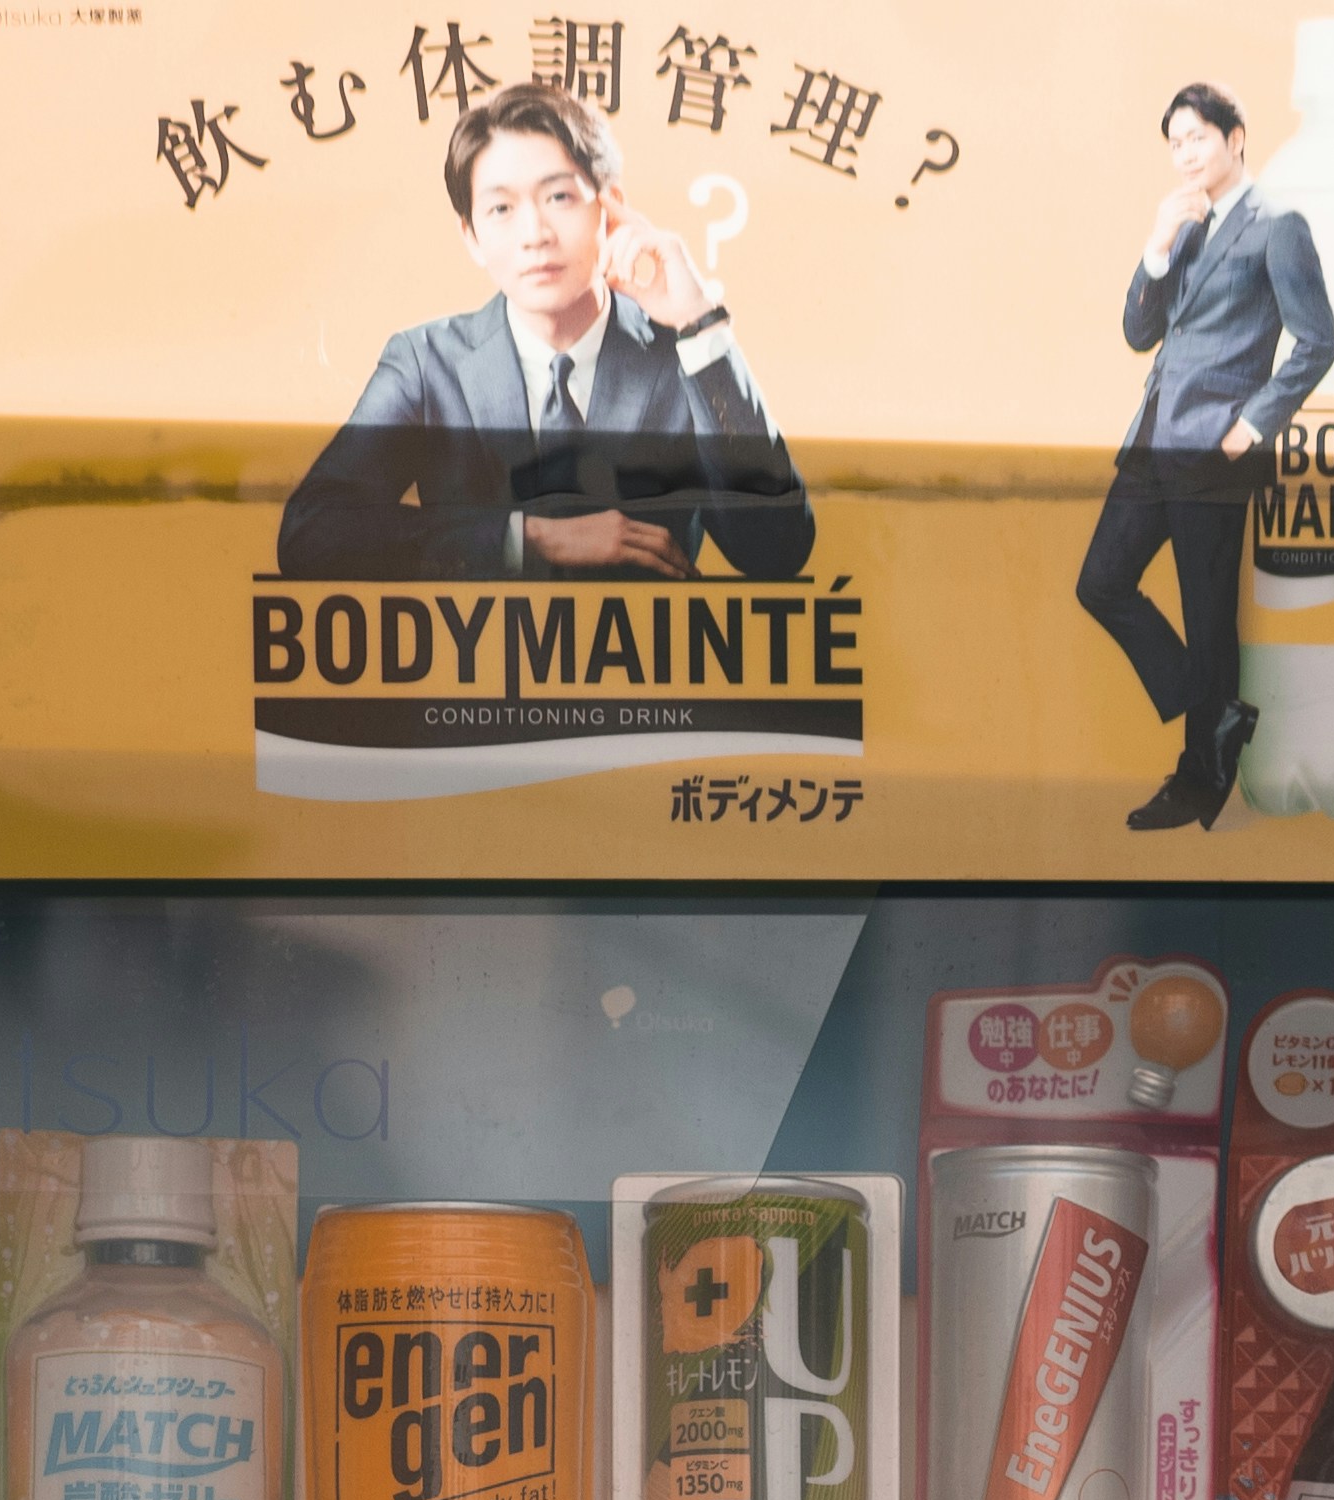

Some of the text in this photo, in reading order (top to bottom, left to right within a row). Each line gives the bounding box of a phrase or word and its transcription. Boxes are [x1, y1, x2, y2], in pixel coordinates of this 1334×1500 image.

[253, 575, 863, 699] BODYMAINTÉ
[425, 705, 694, 726] CONDITIONING DRINK
[670, 779, 863, 824] ボディメンテ
[988, 1069, 1099, 1102] のあなたに!
[953, 1211, 1026, 1240] MATCH
[345, 1331, 540, 1419] ener
[1005, 1228, 1122, 1497] EneGENIUS
[44, 1411, 254, 1477] MATCH
